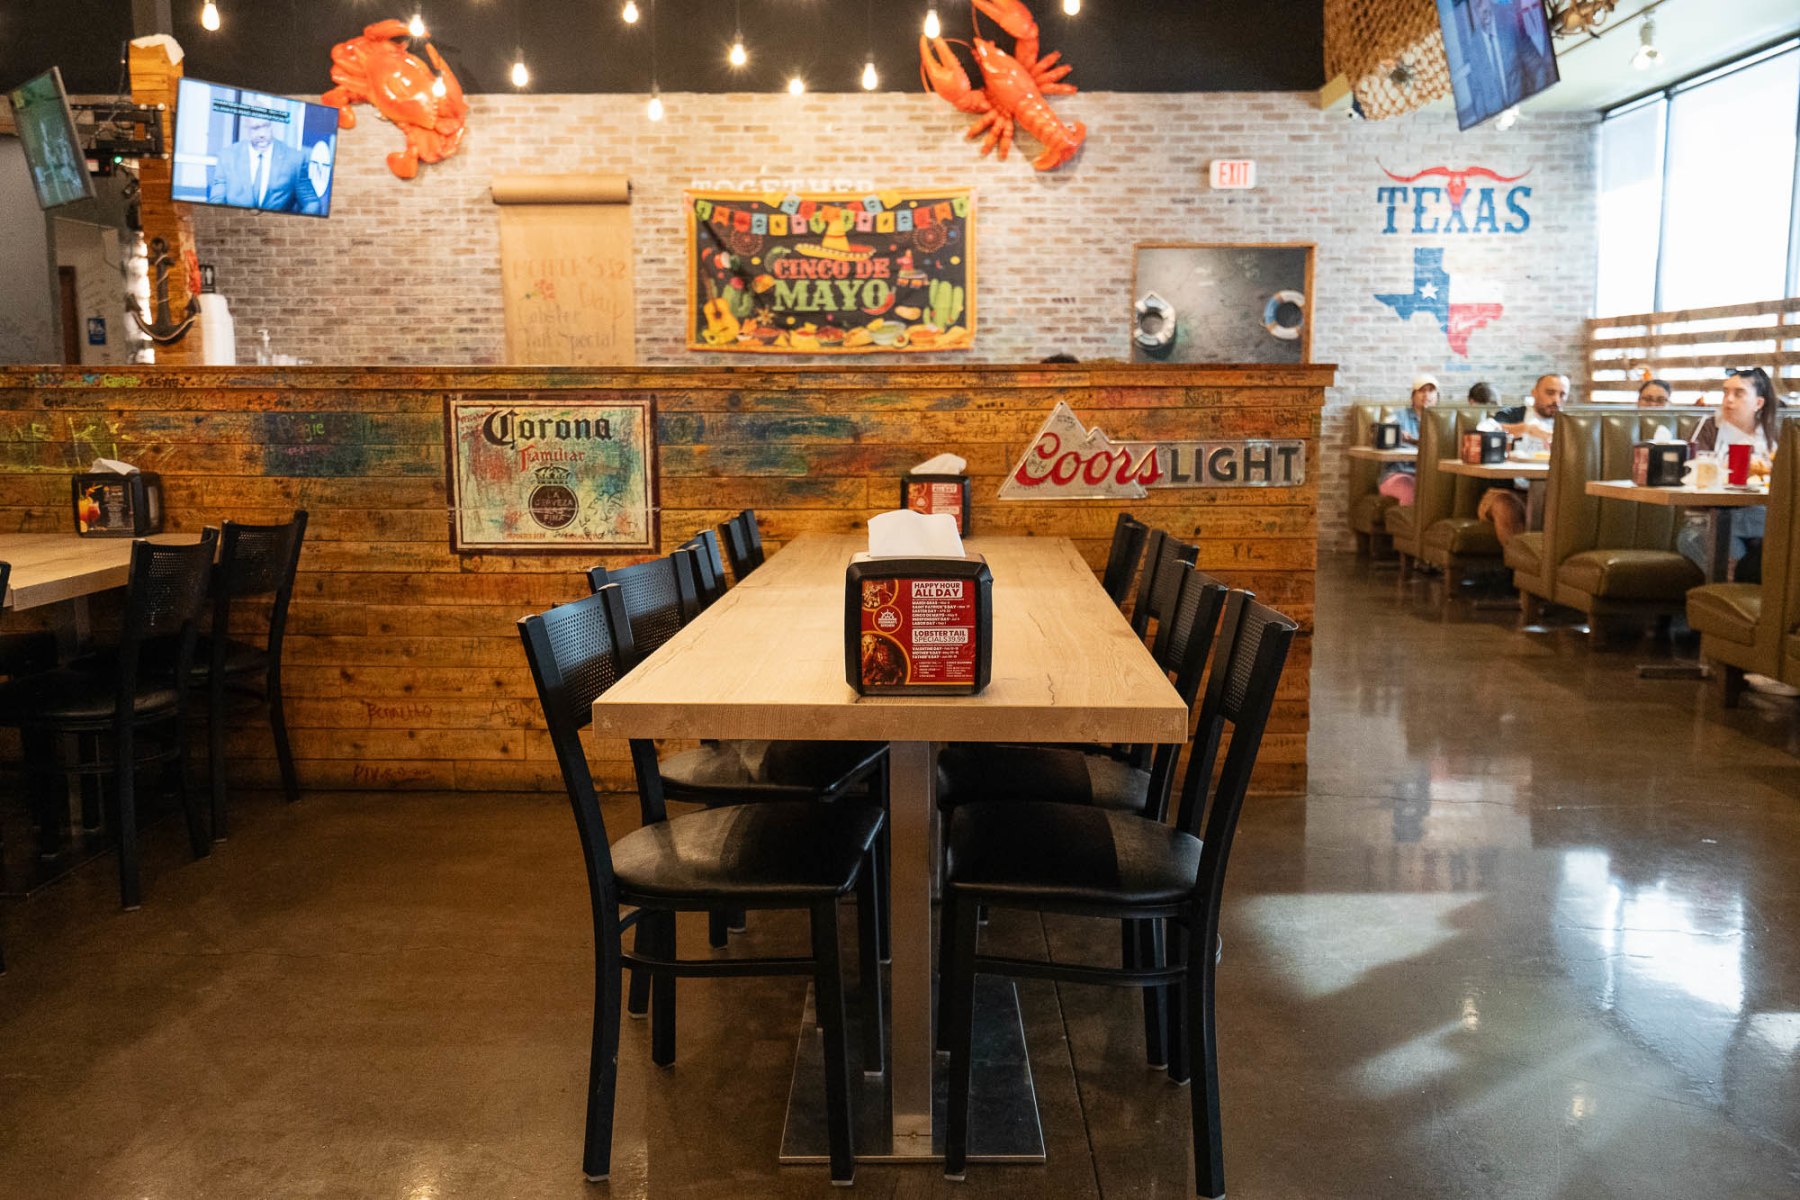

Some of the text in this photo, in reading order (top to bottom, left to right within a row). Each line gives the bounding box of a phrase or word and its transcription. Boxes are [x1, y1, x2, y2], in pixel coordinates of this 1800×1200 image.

[1217, 162, 1250, 186] EXIT
[1376, 186, 1533, 234] TEXAS
[773, 257, 891, 280] CINCO DE
[771, 279, 892, 312] MAYO
[482, 408, 614, 450] Corona
[517, 444, 586, 473] Familiar
[1014, 432, 1300, 486] Coors LIGHT
[914, 589, 960, 597] ALL DAY
